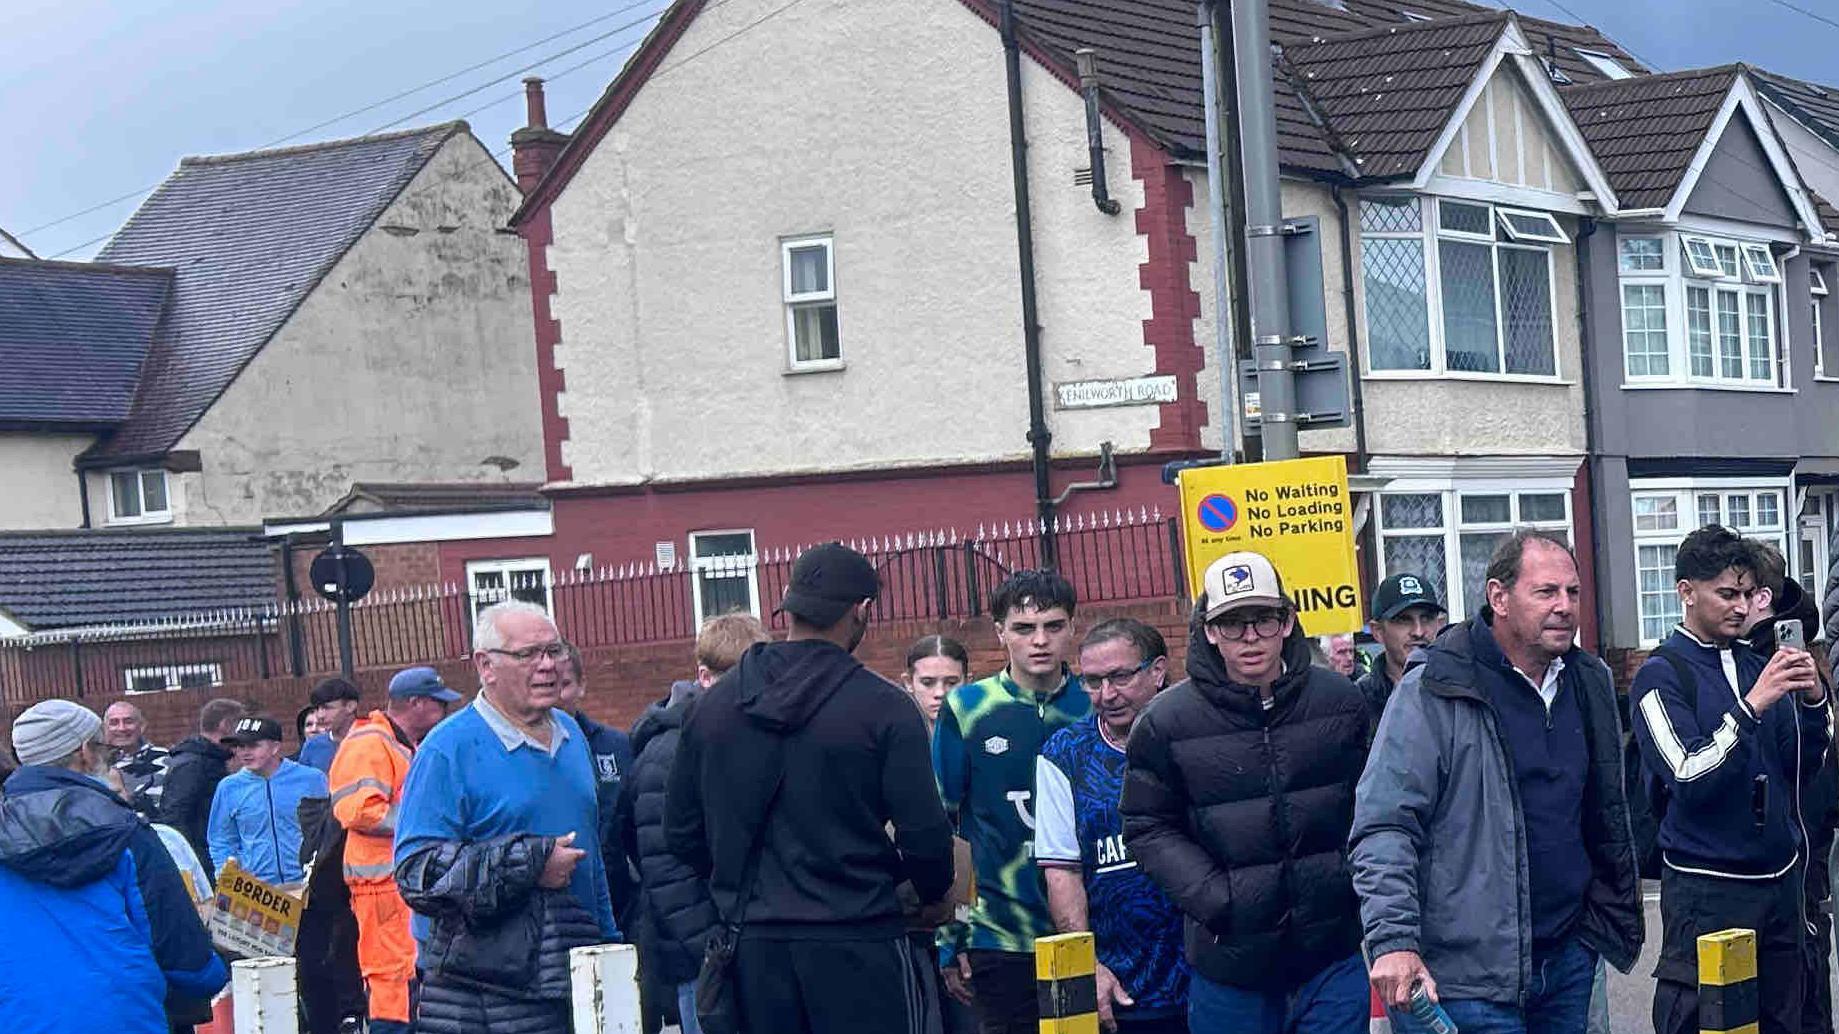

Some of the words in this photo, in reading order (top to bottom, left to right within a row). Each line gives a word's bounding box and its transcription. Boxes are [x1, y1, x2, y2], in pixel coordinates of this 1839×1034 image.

[1137, 383, 1173, 398] ROAD
[1246, 489, 1268, 502] No
[1275, 484, 1338, 500] Waiting
[1248, 507, 1271, 520] No
[1277, 501, 1342, 518] Loading
[1250, 525, 1273, 538] No
[1280, 519, 1343, 536] Parking
[233, 877, 290, 917] BORDER
